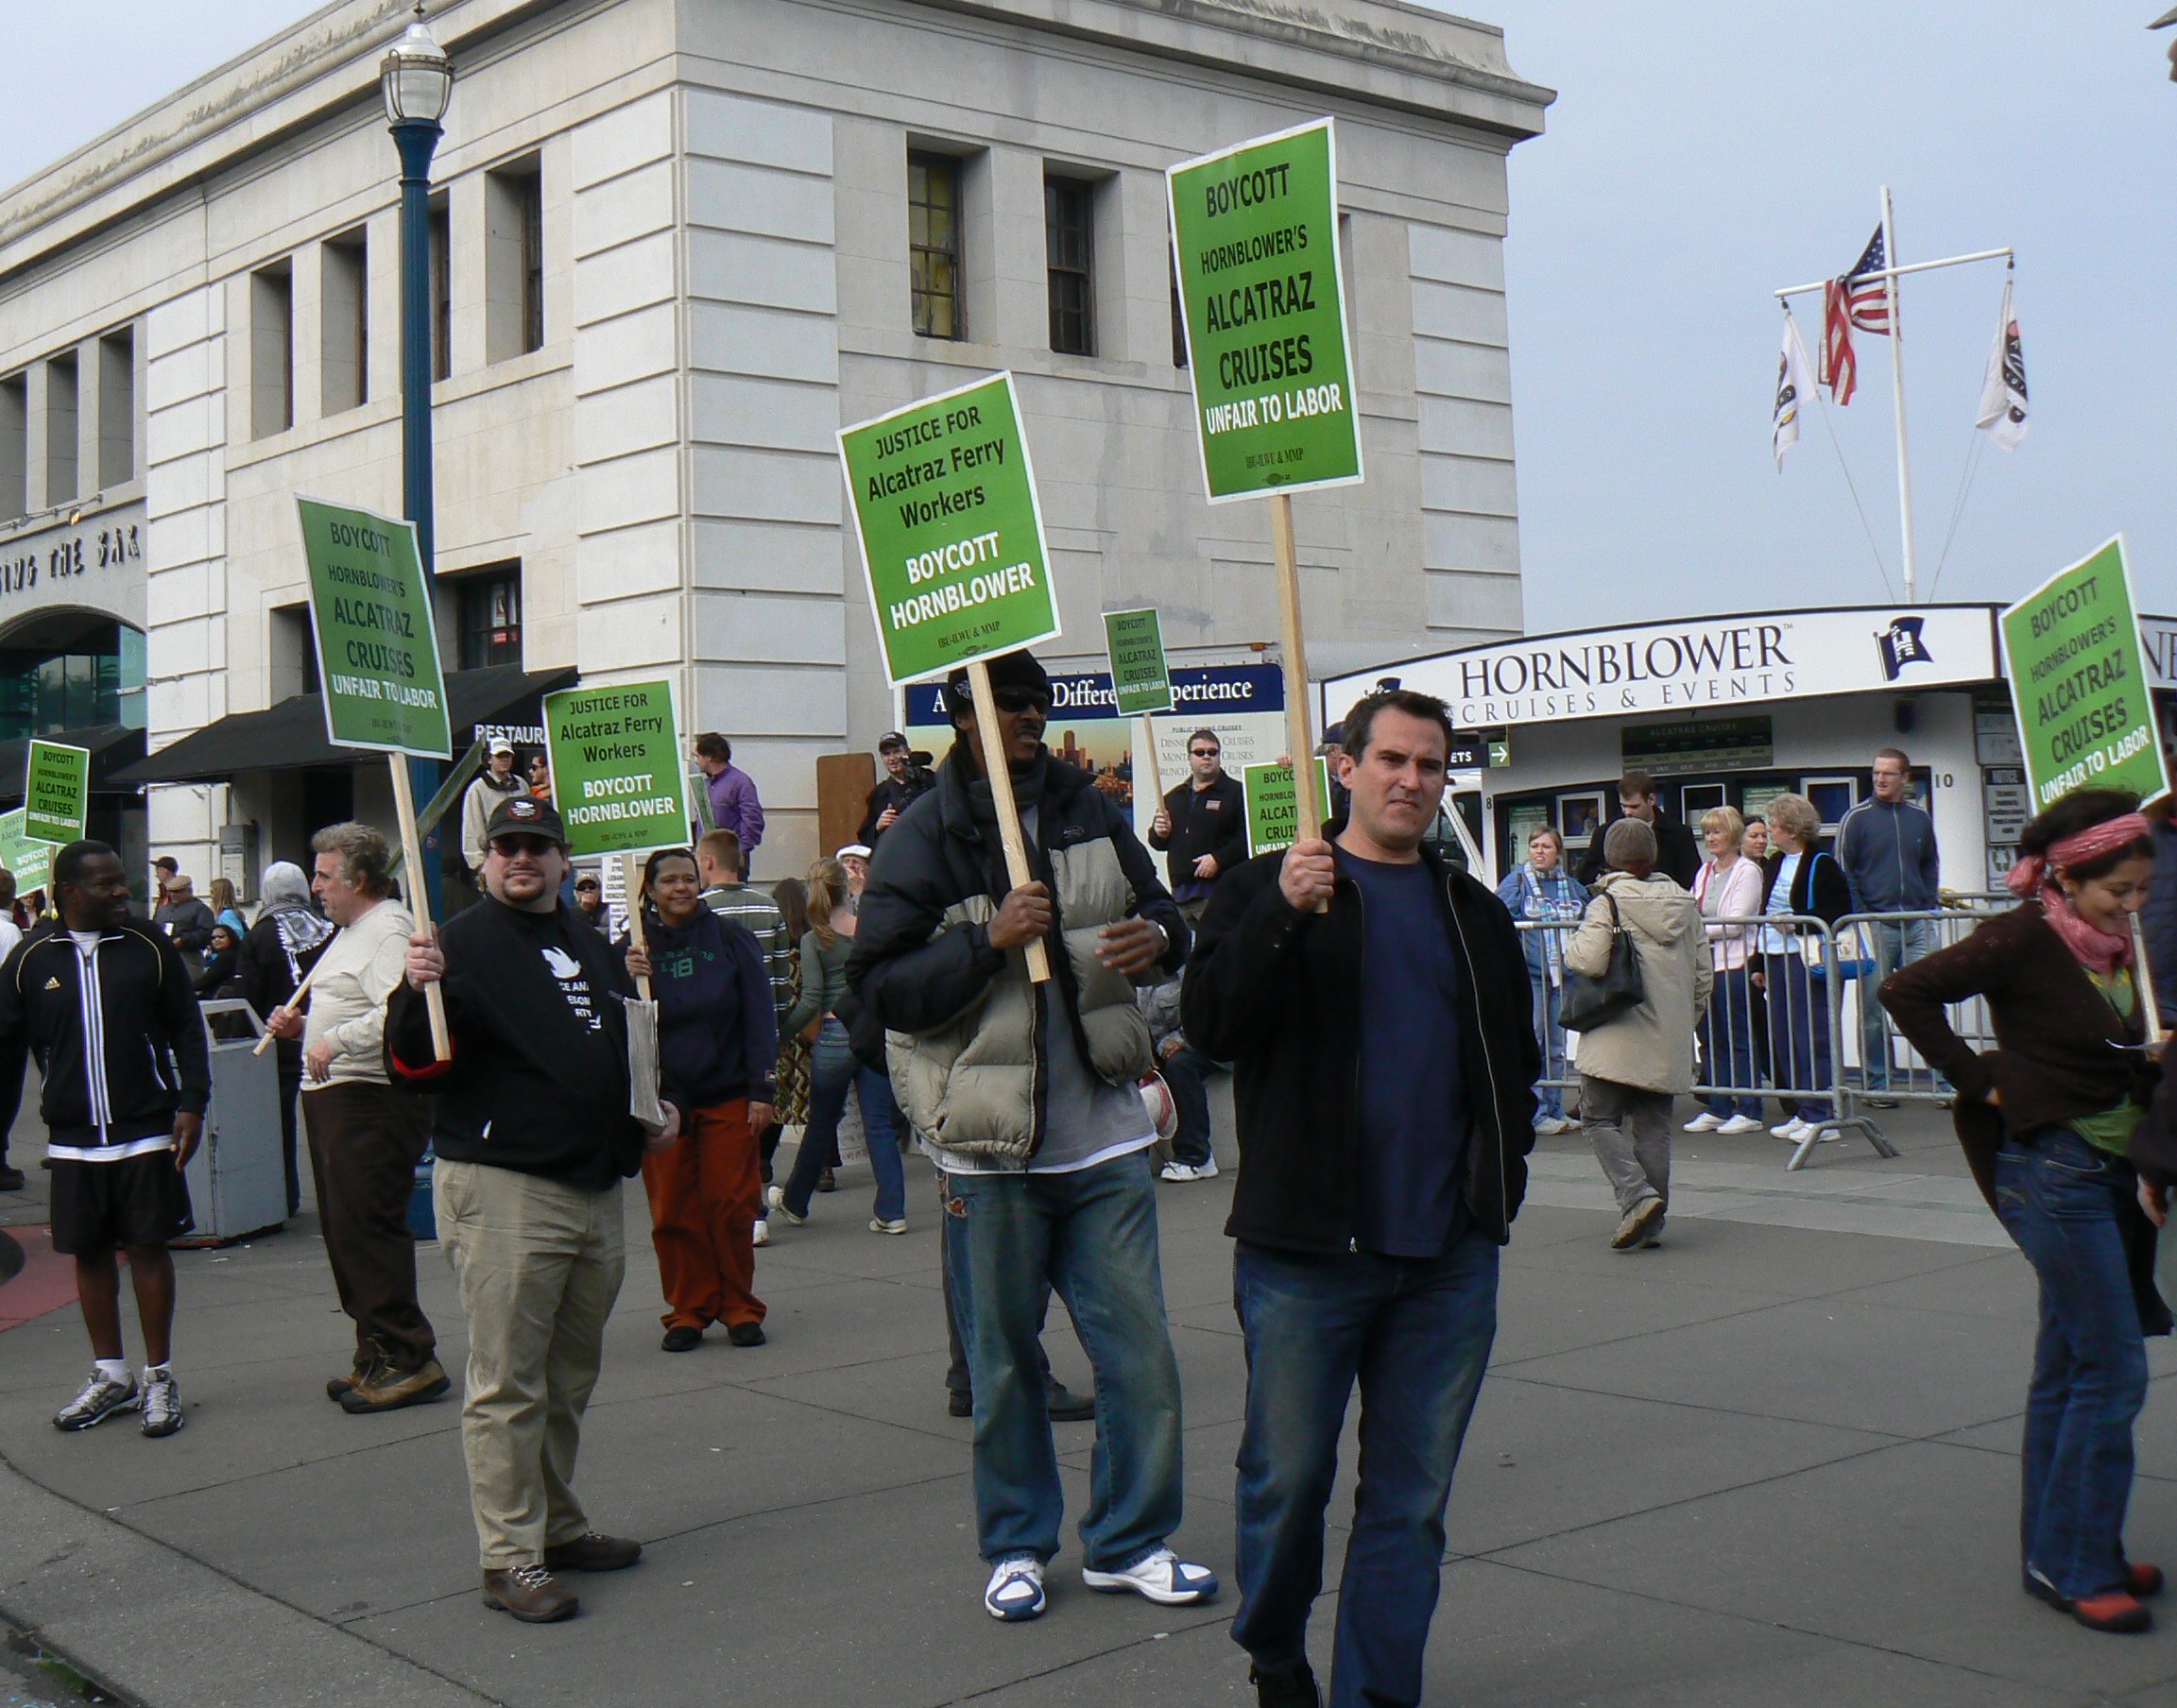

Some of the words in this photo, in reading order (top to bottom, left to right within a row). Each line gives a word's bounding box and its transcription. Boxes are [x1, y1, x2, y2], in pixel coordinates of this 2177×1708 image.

[1206, 162, 1290, 217] BOYCOTT
[1200, 224, 1308, 275] HORNBLOWER'S
[1206, 270, 1315, 333] ALCATRAZ
[1219, 334, 1312, 390] CRUISES
[1205, 399, 1258, 435] UNFAIR
[1260, 394, 1282, 424] TO
[1284, 383, 1344, 420] LABOR
[875, 418, 942, 460] JUSTICE
[947, 405, 982, 435] FOR
[868, 457, 947, 502] Alcatraz
[951, 438, 1005, 472] Ferry
[899, 484, 986, 528] Workers
[331, 521, 391, 557] BOYCOTT
[905, 531, 1000, 585] BOYCOTT
[328, 564, 406, 598] HORNBLOWER'S
[890, 562, 1036, 630] HORNBLOWER
[334, 596, 415, 639] ALCATRAZ
[1117, 618, 1145, 631] BOYCOTT
[2031, 576, 2100, 639] BOYCOTT
[346, 640, 415, 678] CRUISES
[1119, 649, 1157, 665] ALCATRAZ
[1458, 624, 1794, 699] HORNBLOWER
[2031, 616, 2117, 683] HORNBLOWER'S
[332, 674, 382, 700] UNFAIR
[383, 679, 400, 702] TO
[400, 684, 438, 709] LABOR
[1123, 666, 1157, 682] CRUISES
[2039, 649, 2126, 726] ALCATRAZ
[570, 696, 621, 716] JUSTICE
[624, 693, 648, 709] FOR
[932, 689, 947, 712] A
[1462, 692, 1596, 724] CRUISES
[1620, 688, 1637, 709] &
[1662, 672, 1795, 705] EVENTS
[560, 721, 621, 742] Alcatraz
[625, 716, 663, 734] Ferry
[1160, 739, 1188, 747] DINNE
[2051, 697, 2128, 763] CRUISES
[43, 751, 75, 765] BOYCOTT
[583, 743, 646, 763] Workers
[2040, 761, 2087, 805] UNFAIR
[2084, 750, 2105, 777] TO
[2107, 725, 2151, 766] LABOR
[36, 781, 77, 798] ALCATRAZ
[582, 774, 653, 799] BOYCOTT
[1934, 773, 1954, 788] 10
[38, 798, 73, 815] CRUISES
[567, 796, 676, 826] HORNBLOWER
[1260, 806, 1297, 821] ALCAT
[1486, 797, 1492, 810] 8
[1265, 825, 1297, 840] CRUI
